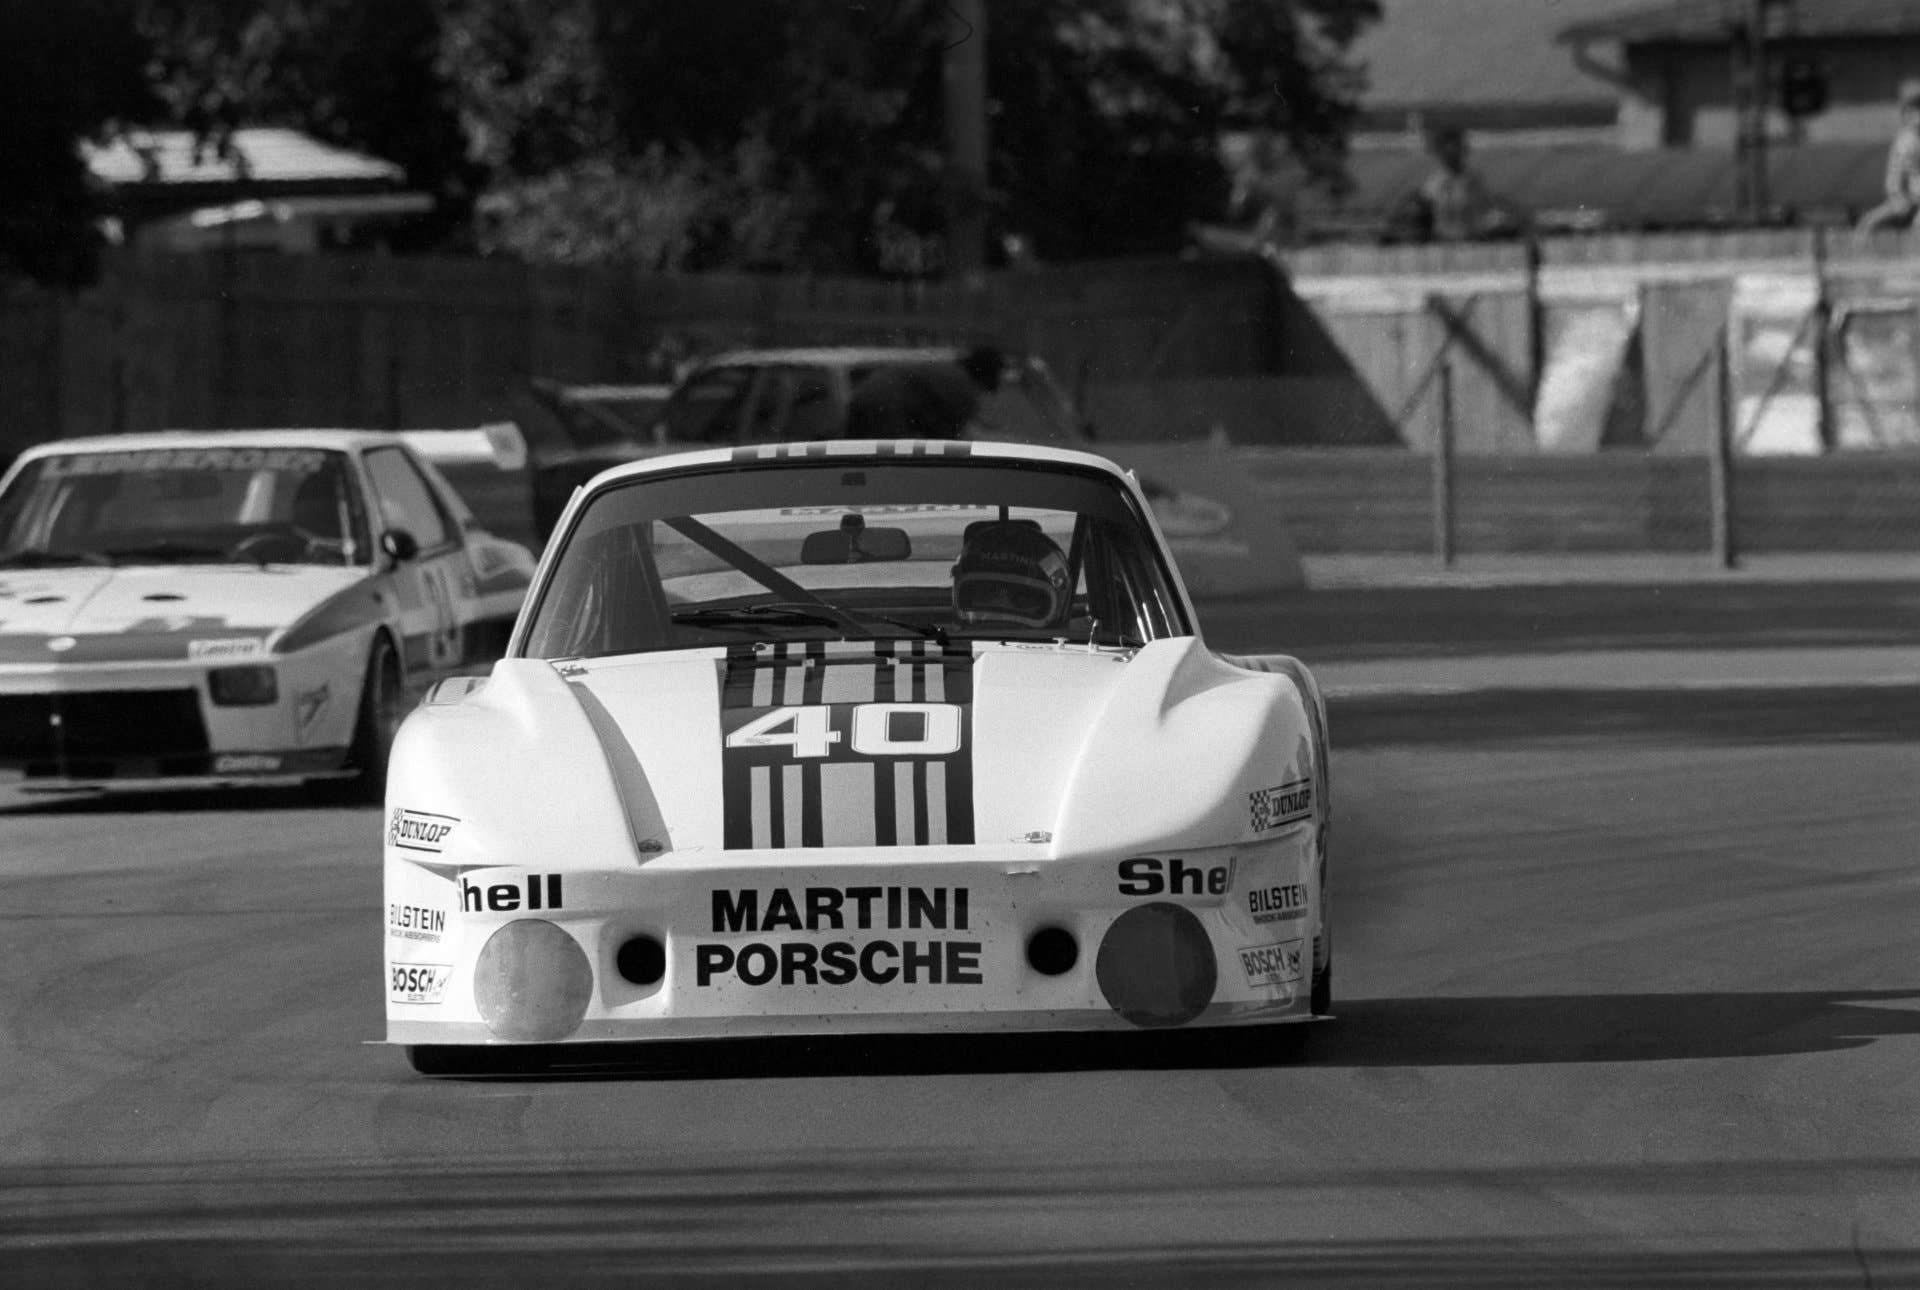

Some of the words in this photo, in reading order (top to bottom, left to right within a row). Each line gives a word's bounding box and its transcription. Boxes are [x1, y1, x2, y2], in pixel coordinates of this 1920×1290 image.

[726, 703, 962, 758] 40
[1272, 788, 1312, 817] DUNLOP
[400, 820, 451, 843] DUNLOP
[712, 887, 968, 932] MARTINI
[1249, 885, 1308, 912] BILSTEIN
[697, 941, 982, 986] PORSCHE
[1241, 948, 1285, 976] BOSCH
[393, 967, 437, 993] BOSCH
